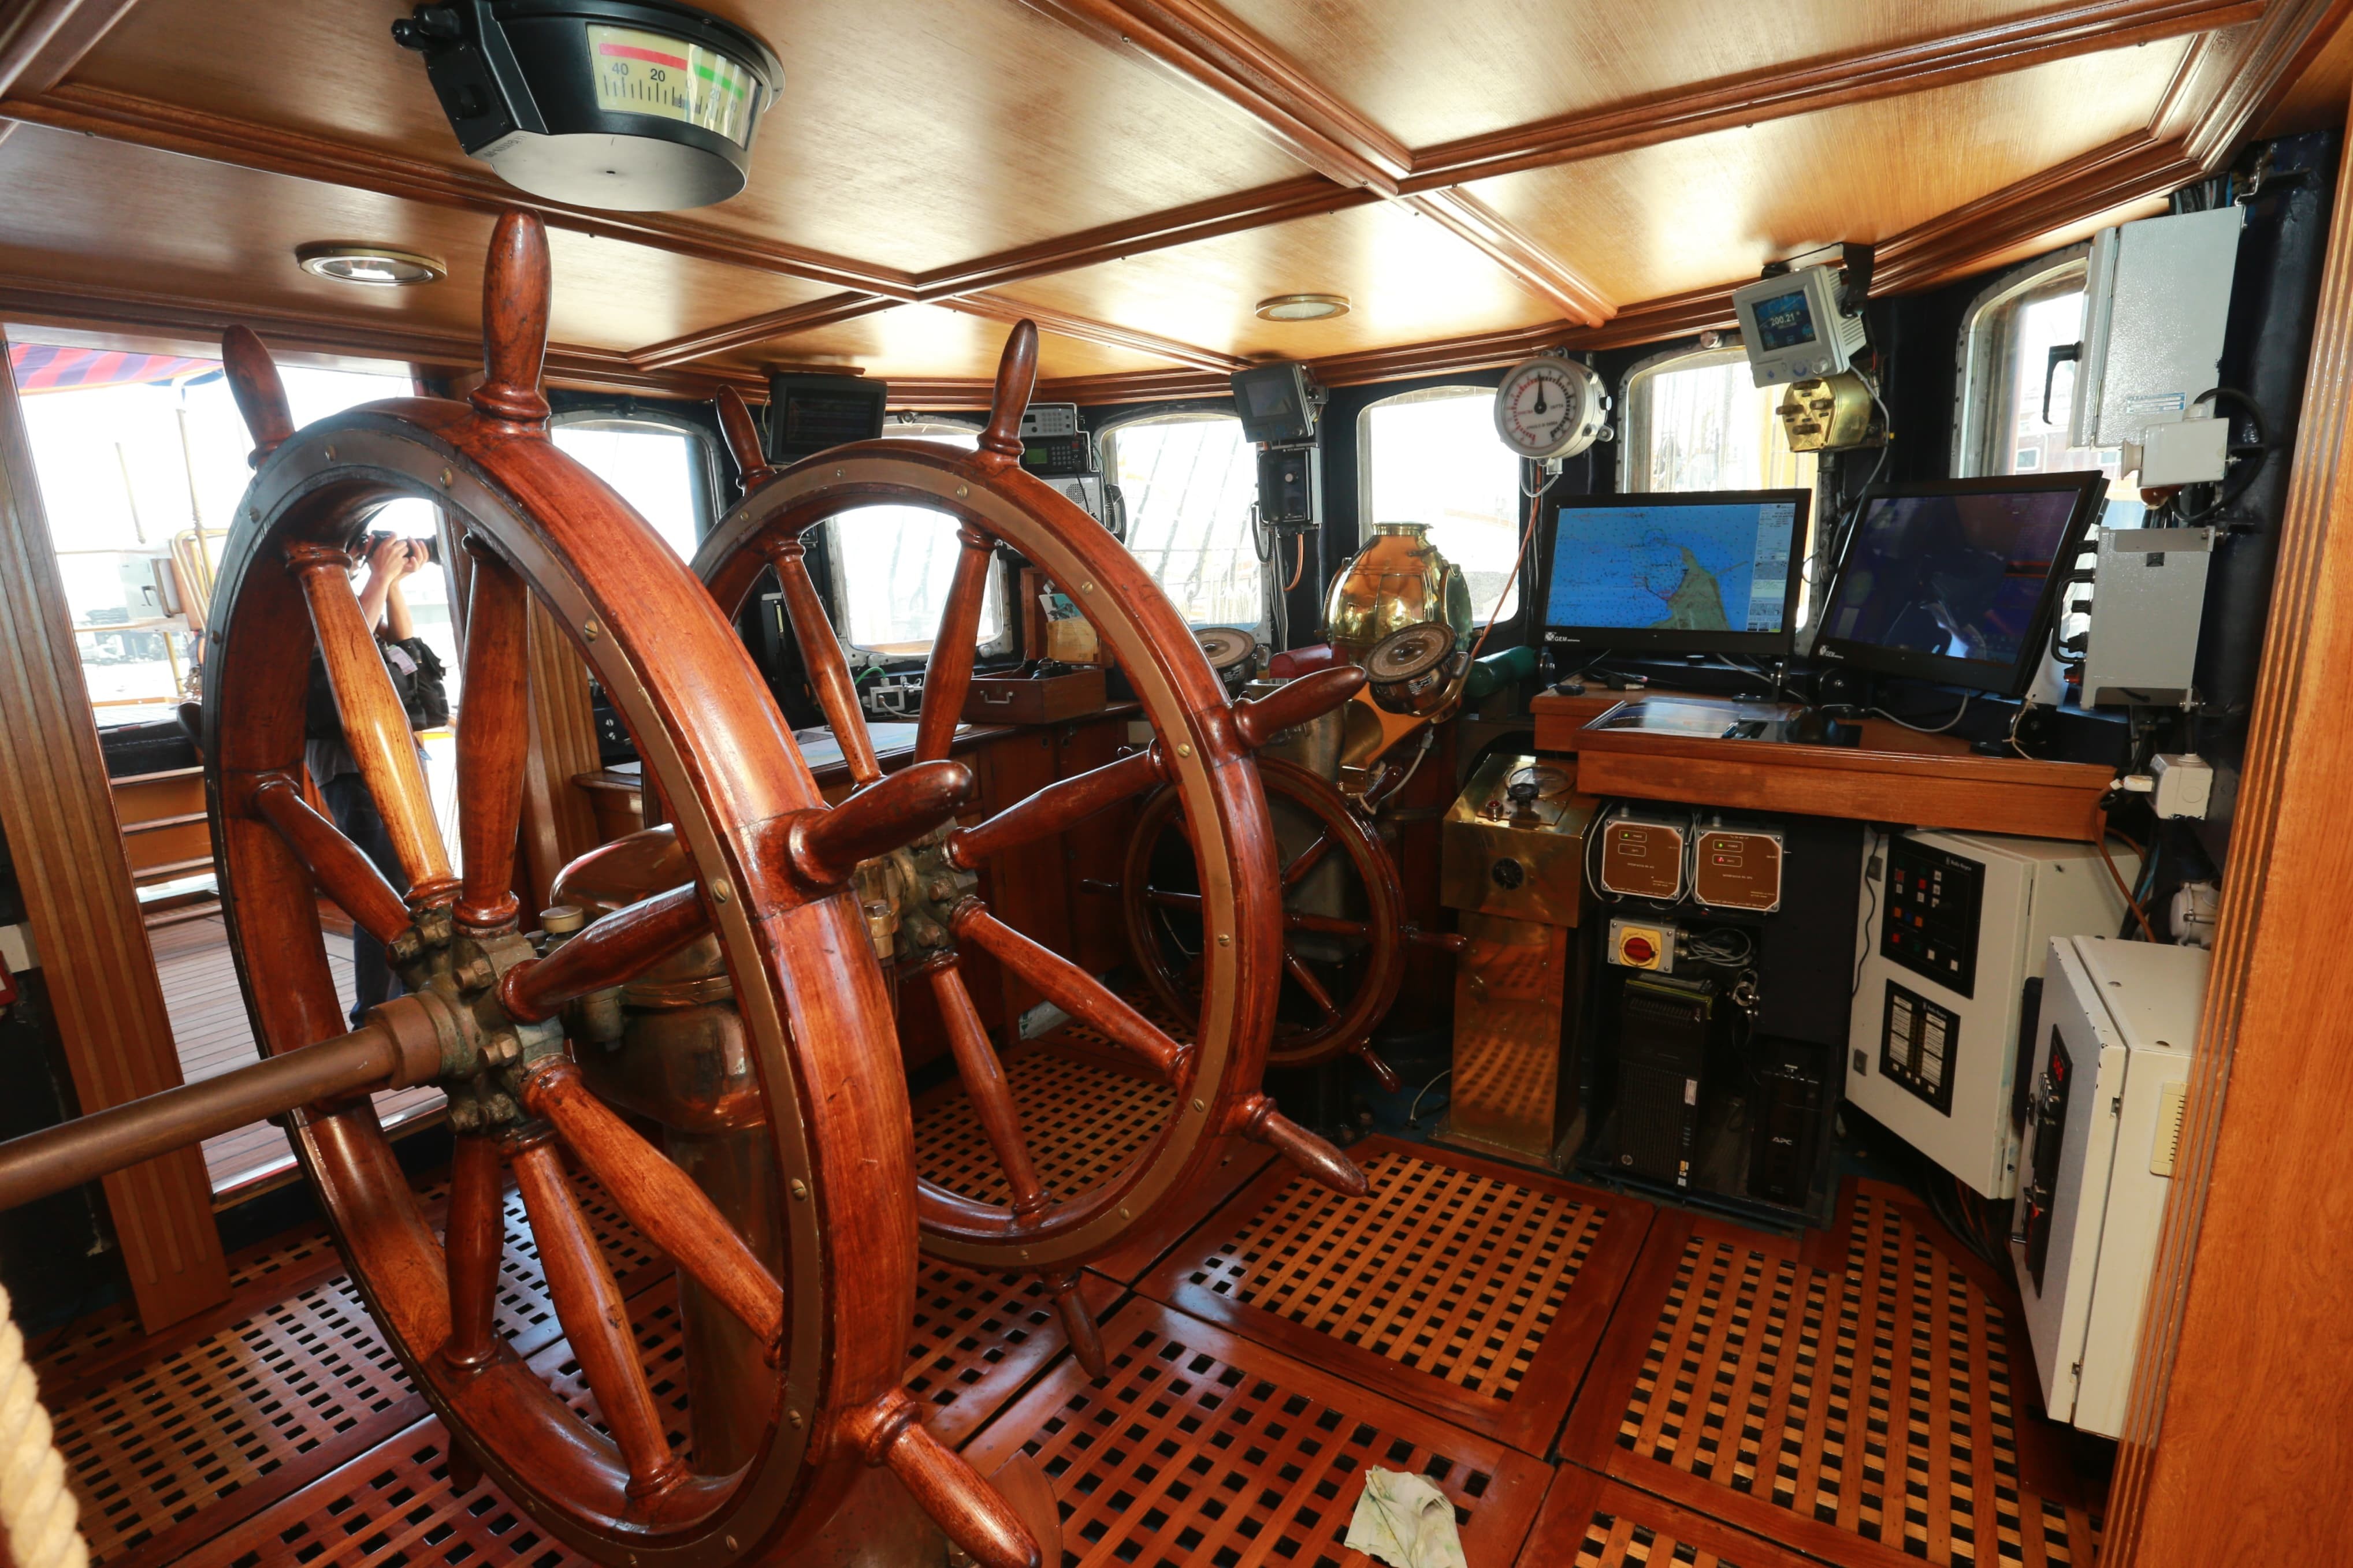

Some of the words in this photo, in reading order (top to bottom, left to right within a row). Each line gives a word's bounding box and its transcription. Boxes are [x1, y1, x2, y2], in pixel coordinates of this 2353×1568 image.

[612, 62, 629, 76] 40
[650, 68, 666, 82] 20
[1772, 1137, 1793, 1146] APC
